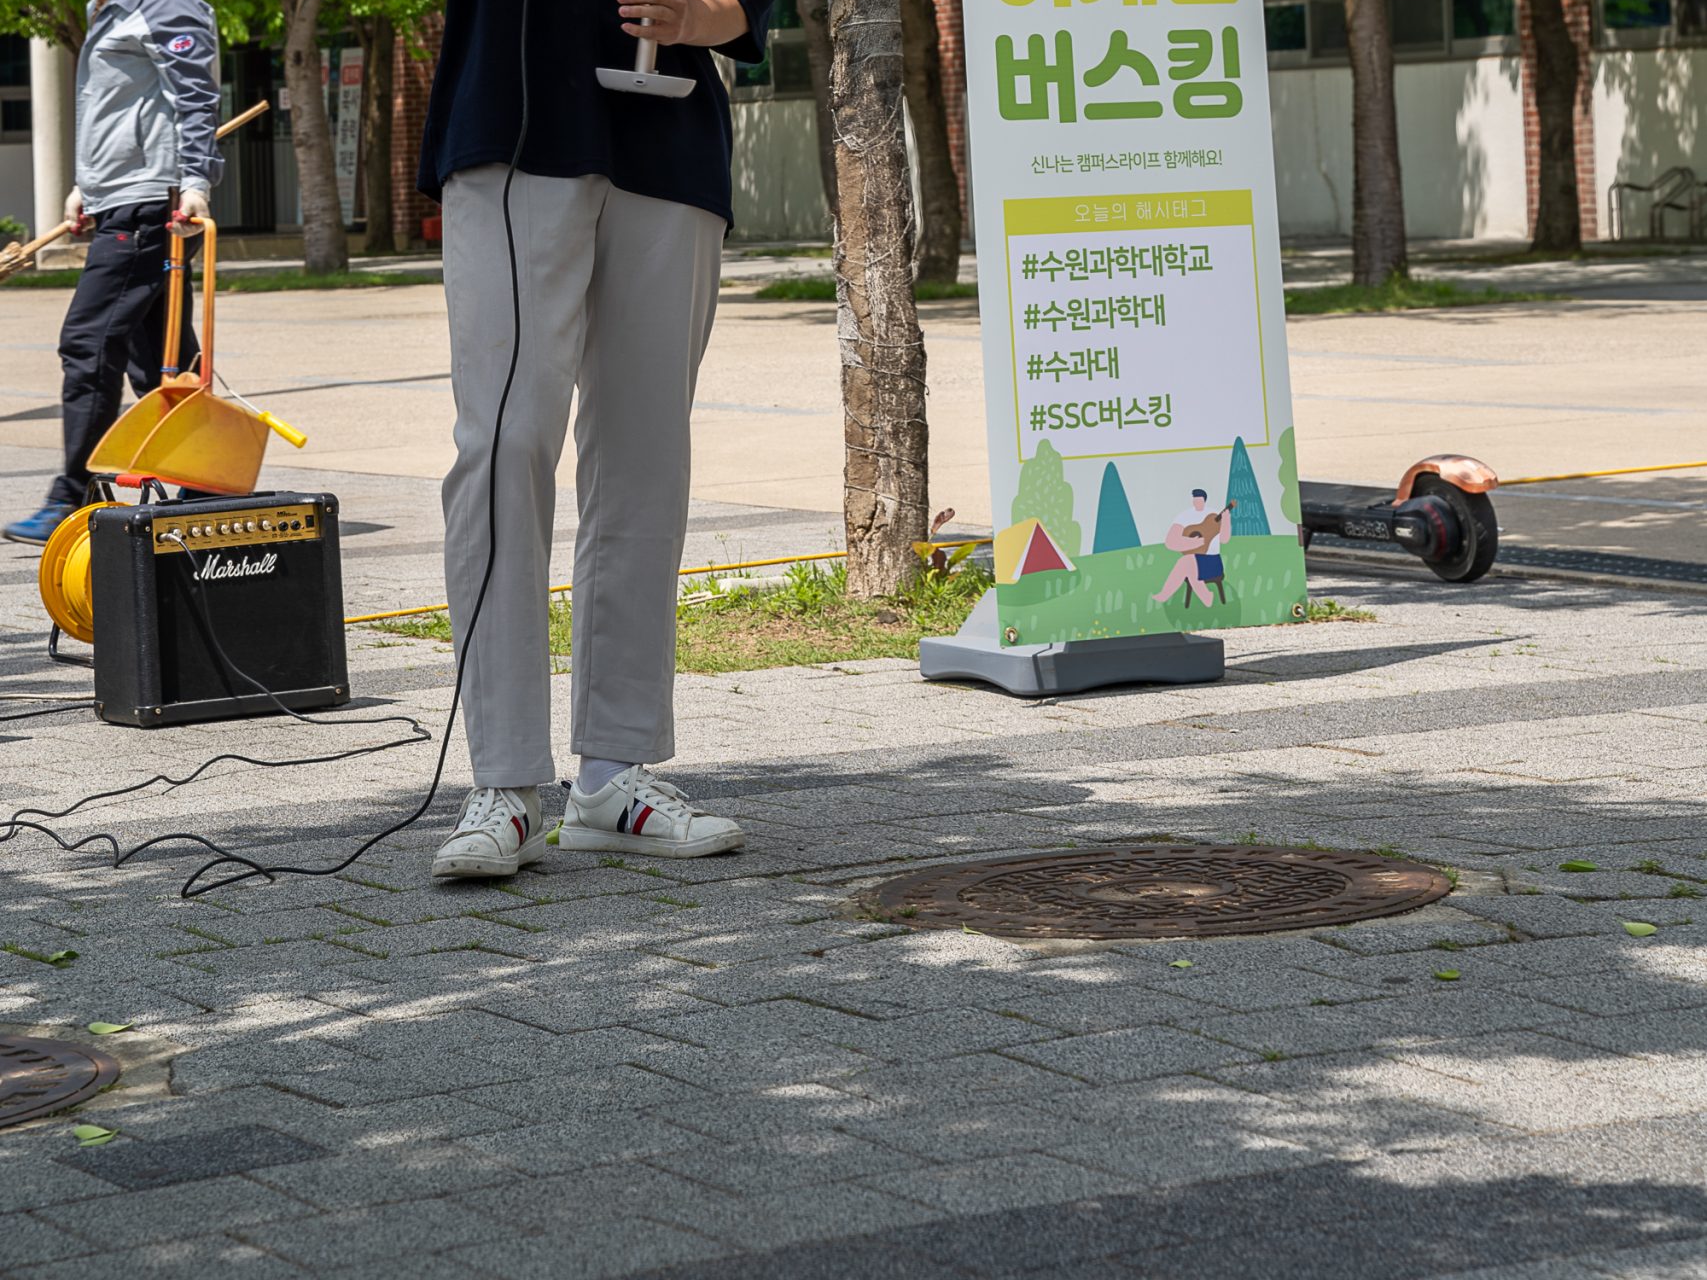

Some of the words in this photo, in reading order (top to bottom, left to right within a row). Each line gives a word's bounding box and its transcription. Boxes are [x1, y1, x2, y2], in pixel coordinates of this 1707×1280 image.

[995, 26, 1243, 123] 버스킹
[1031, 155, 1075, 174] 신나는
[1077, 152, 1162, 173] 캠퍼스라이프
[1163, 149, 1223, 169] 함께해요!
[1074, 202, 1127, 223] 오늘의
[1136, 199, 1207, 220] 해시태그
[1022, 243, 1213, 282] #수원과학대학교
[1024, 293, 1166, 332] #수원과학대
[1027, 346, 1120, 383] #수과대
[1030, 393, 1172, 431] #SSC버스킹
[193, 552, 278, 581] Marshall
